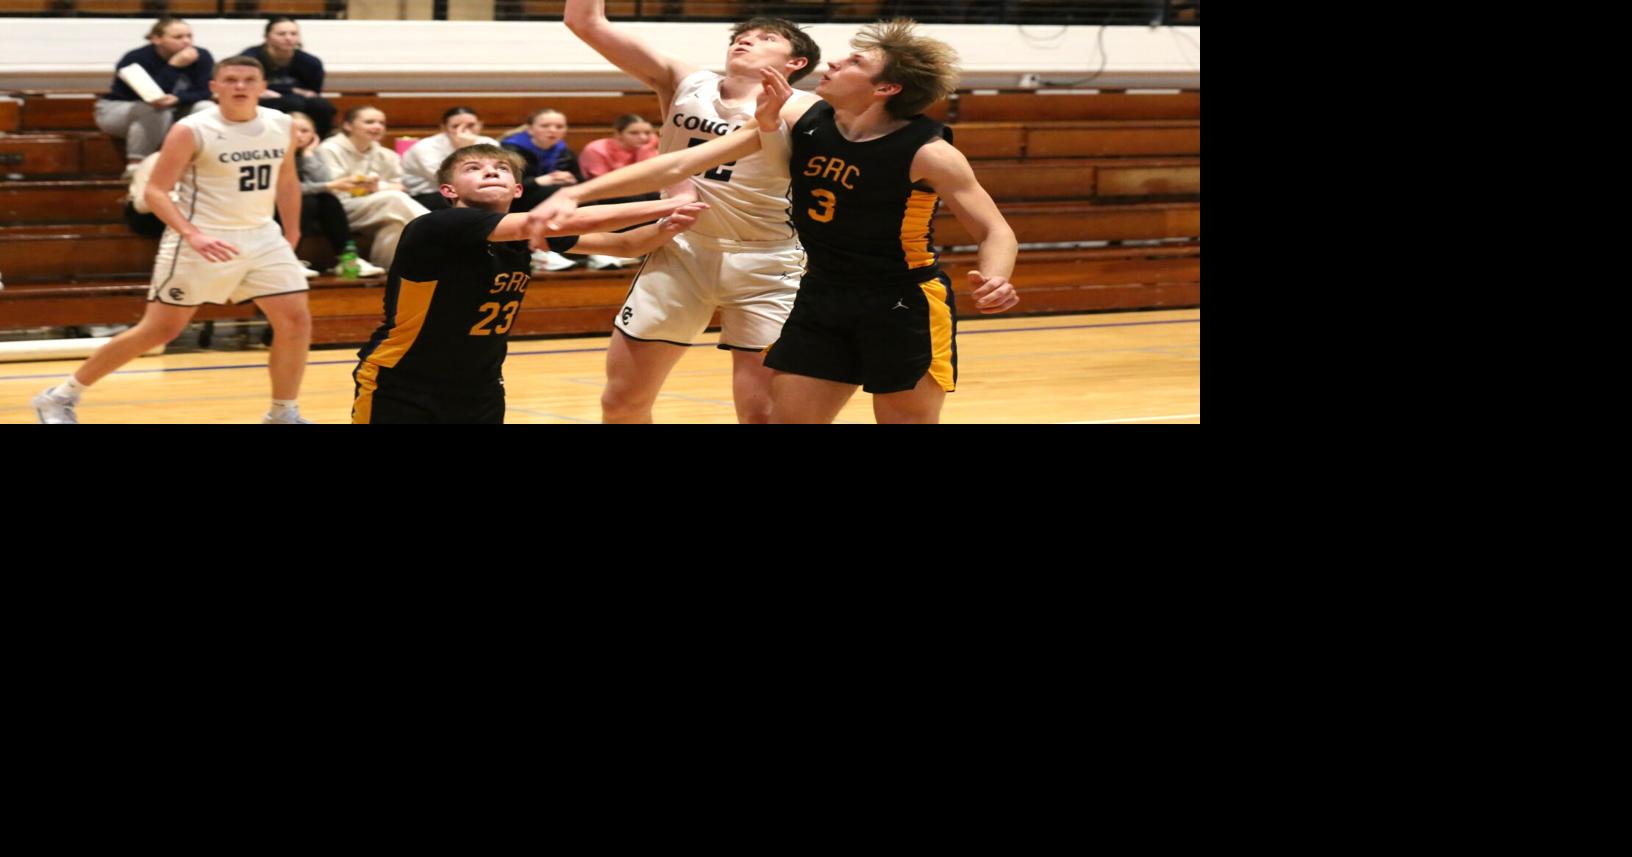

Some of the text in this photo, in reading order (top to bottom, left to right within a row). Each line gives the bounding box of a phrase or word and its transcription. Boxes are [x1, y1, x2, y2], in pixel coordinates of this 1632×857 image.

[672, 113, 742, 136] COUG
[239, 164, 272, 192] 20
[803, 156, 860, 190] SRC
[808, 188, 836, 223] 3
[469, 300, 519, 336] 23
